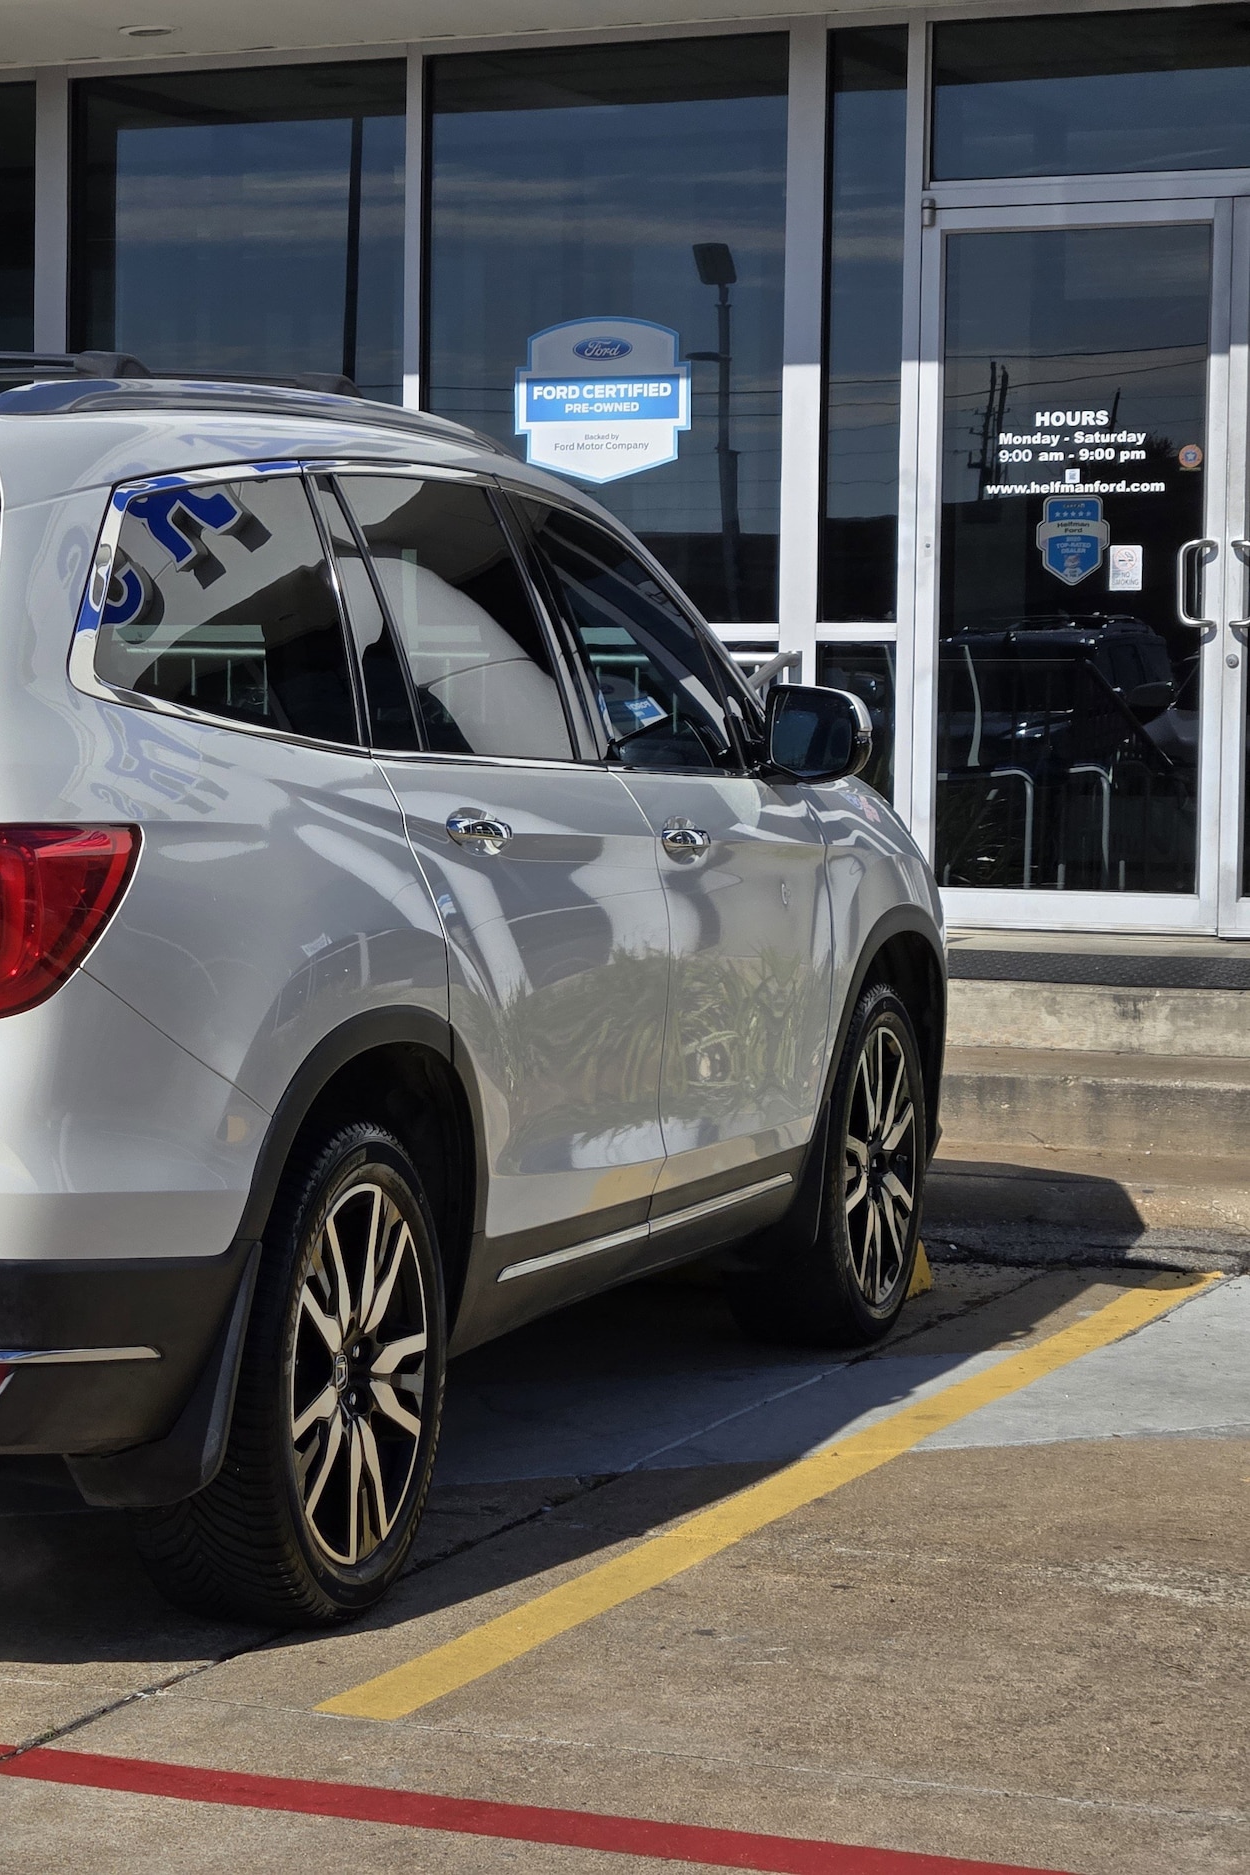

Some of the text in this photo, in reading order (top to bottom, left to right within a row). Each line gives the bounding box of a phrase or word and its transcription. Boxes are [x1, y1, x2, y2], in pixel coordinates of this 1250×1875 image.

[584, 340, 620, 357] Ford
[532, 383, 672, 400] FORD CERTIFIED
[564, 402, 639, 413] PRE-OWNED
[1035, 410, 1109, 427] HOURS
[584, 433, 619, 441] Backed by
[998, 431, 1060, 447] Monday
[1074, 430, 1146, 445] Saturday
[554, 441, 649, 451] Ford Motor Company
[999, 449, 1032, 463] 9:00
[1038, 451, 1064, 462] am
[1079, 447, 1115, 461] 9:00
[1120, 450, 1146, 464] pm
[986, 480, 1166, 495] www.helfmanford.com
